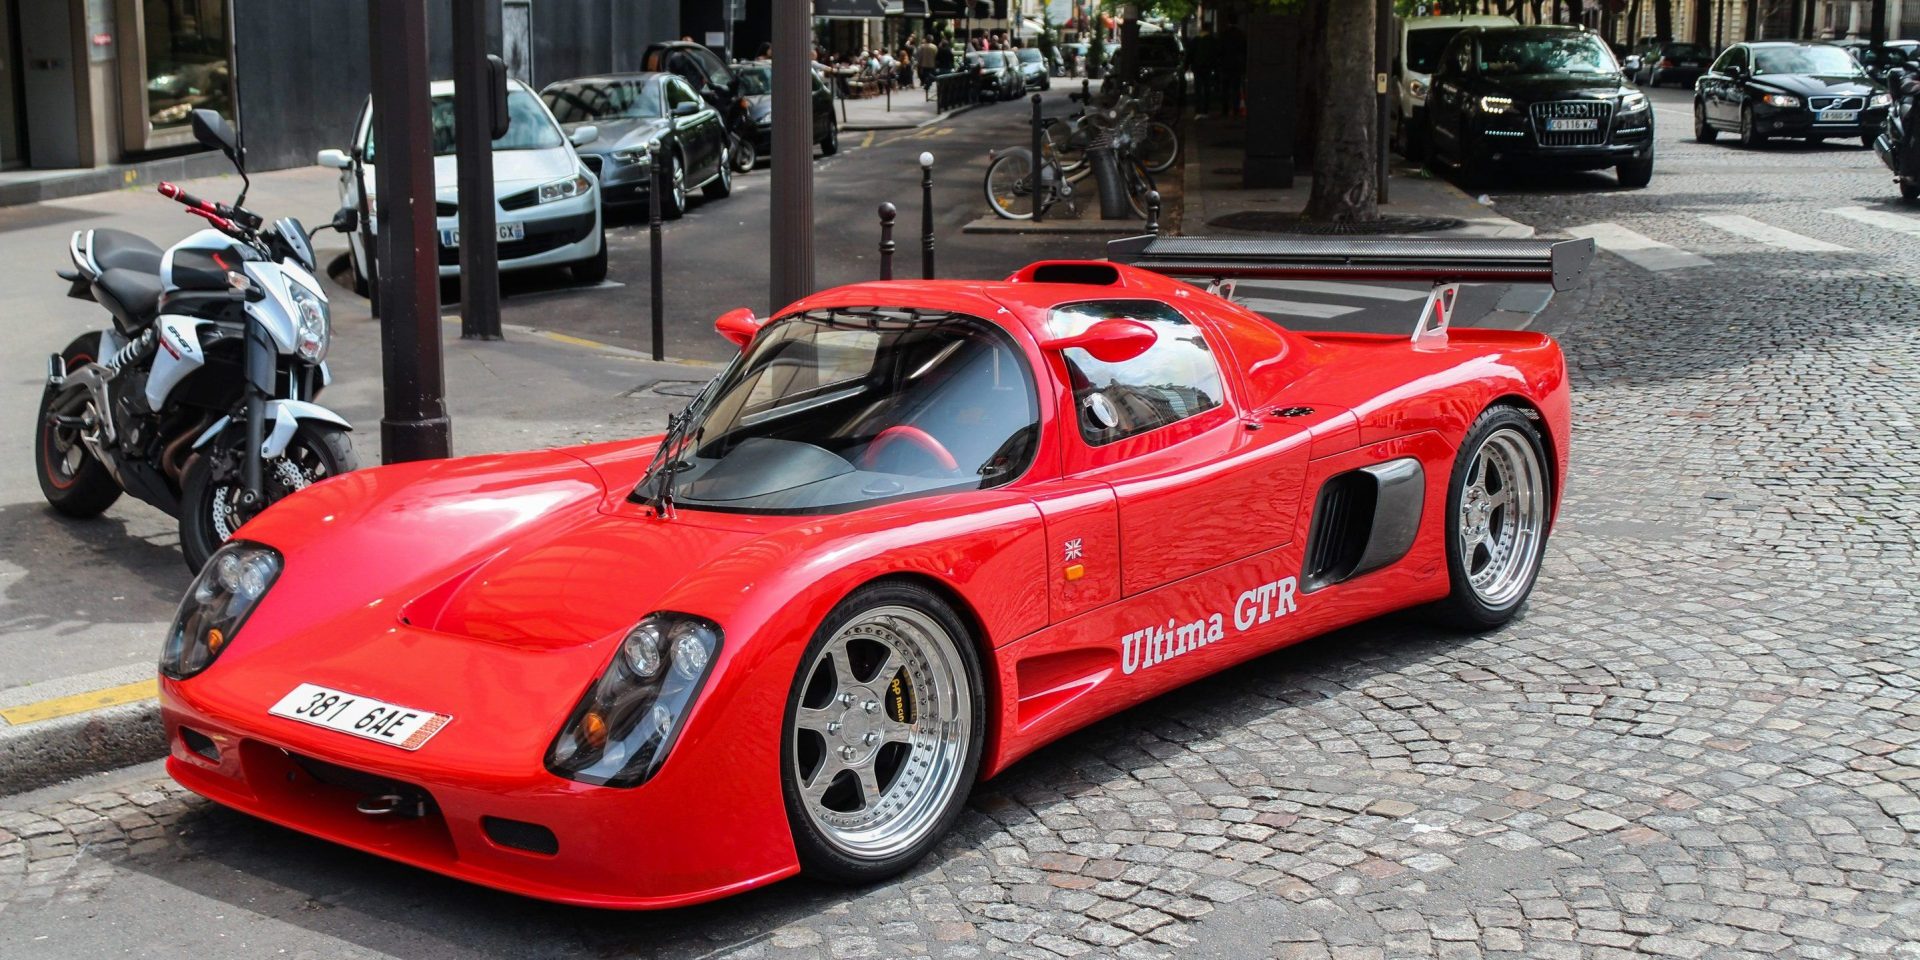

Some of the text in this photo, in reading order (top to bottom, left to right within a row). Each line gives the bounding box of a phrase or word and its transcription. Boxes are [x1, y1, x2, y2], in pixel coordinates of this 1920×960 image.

[1121, 575, 1298, 675] Ultima GTR
[296, 691, 417, 738] 381 6AE
